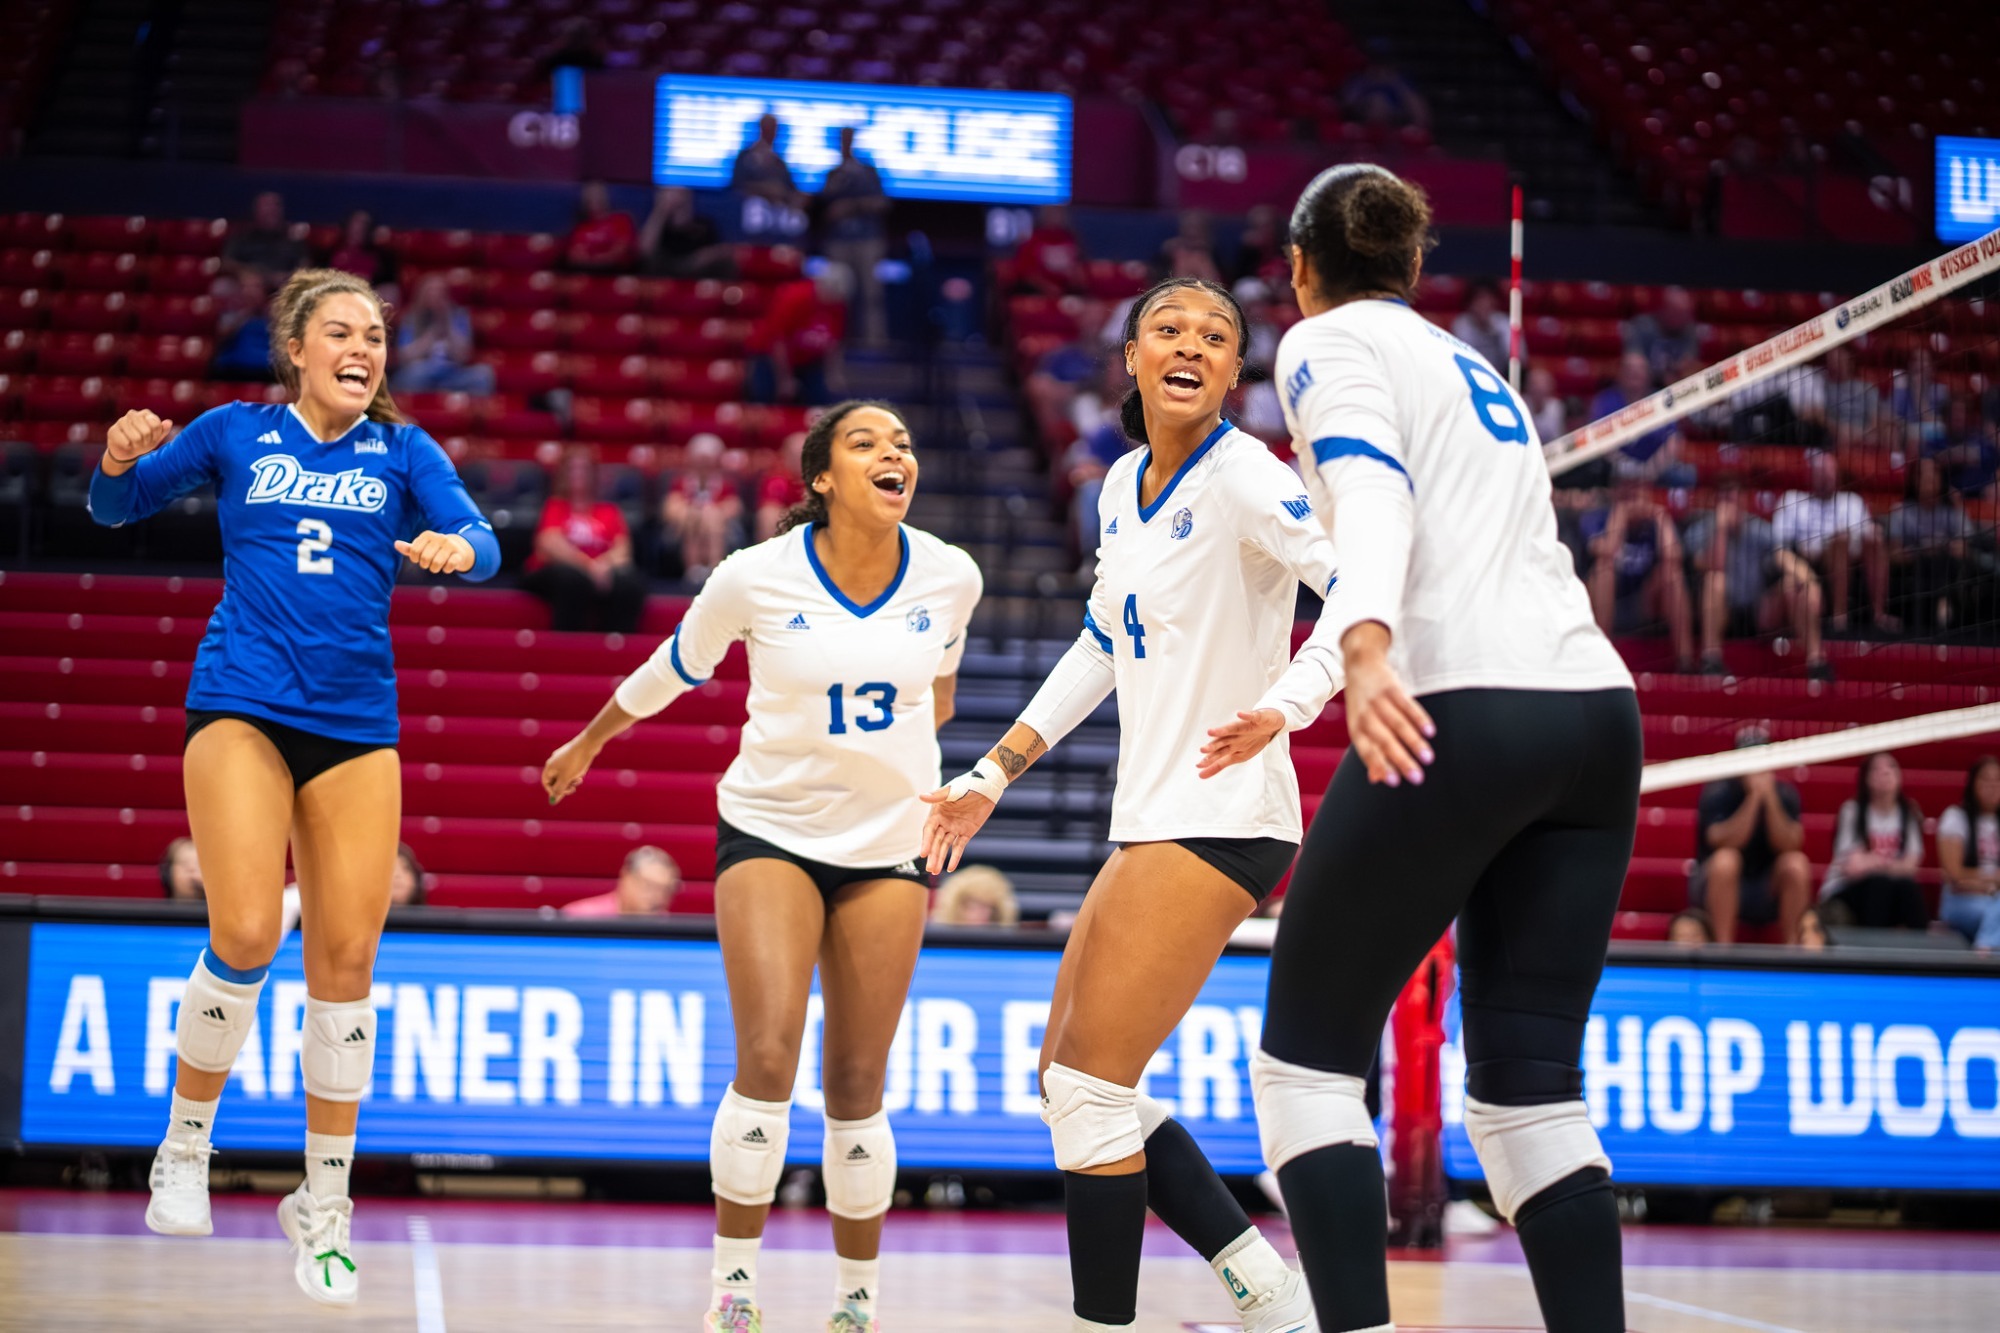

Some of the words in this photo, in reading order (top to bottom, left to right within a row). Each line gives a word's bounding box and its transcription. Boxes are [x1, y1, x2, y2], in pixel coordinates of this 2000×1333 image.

[1949, 156, 2000, 223] W
[1938, 243, 1981, 280] HUSKER
[1454, 353, 1529, 445] 8
[246, 454, 387, 513] Drake
[296, 518, 334, 575] 2
[1123, 594, 1146, 658] 4
[827, 682, 898, 735] 13
[49, 974, 116, 1095] A
[608, 990, 702, 1107] IN
[1582, 1013, 1765, 1134] HOP
